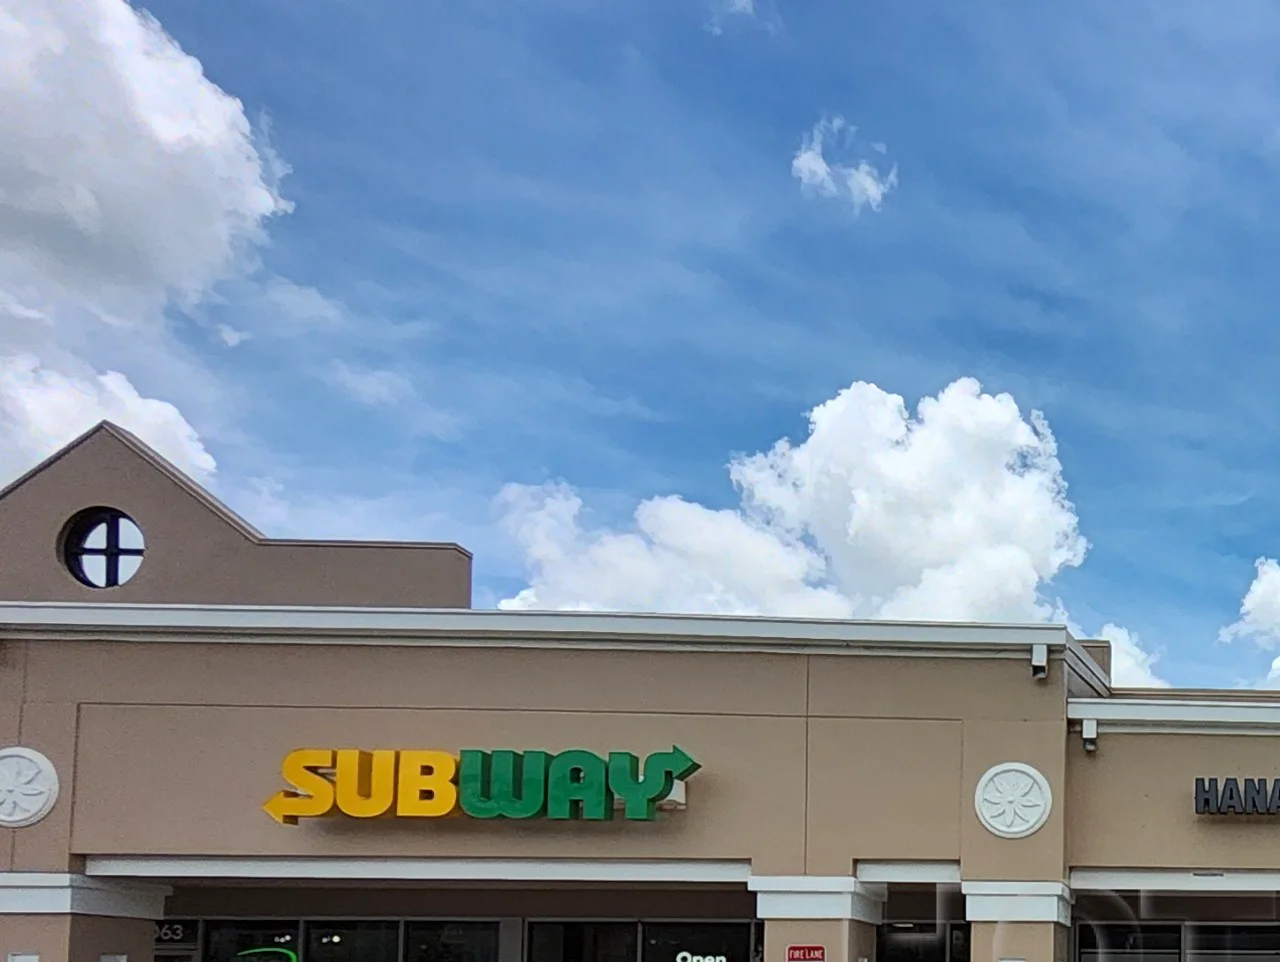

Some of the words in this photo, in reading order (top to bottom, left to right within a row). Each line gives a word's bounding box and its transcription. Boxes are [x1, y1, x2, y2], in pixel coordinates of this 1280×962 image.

[262, 746, 702, 825] SUBWAY
[789, 949, 804, 959] FIRE
[805, 948, 823, 959] LANE
